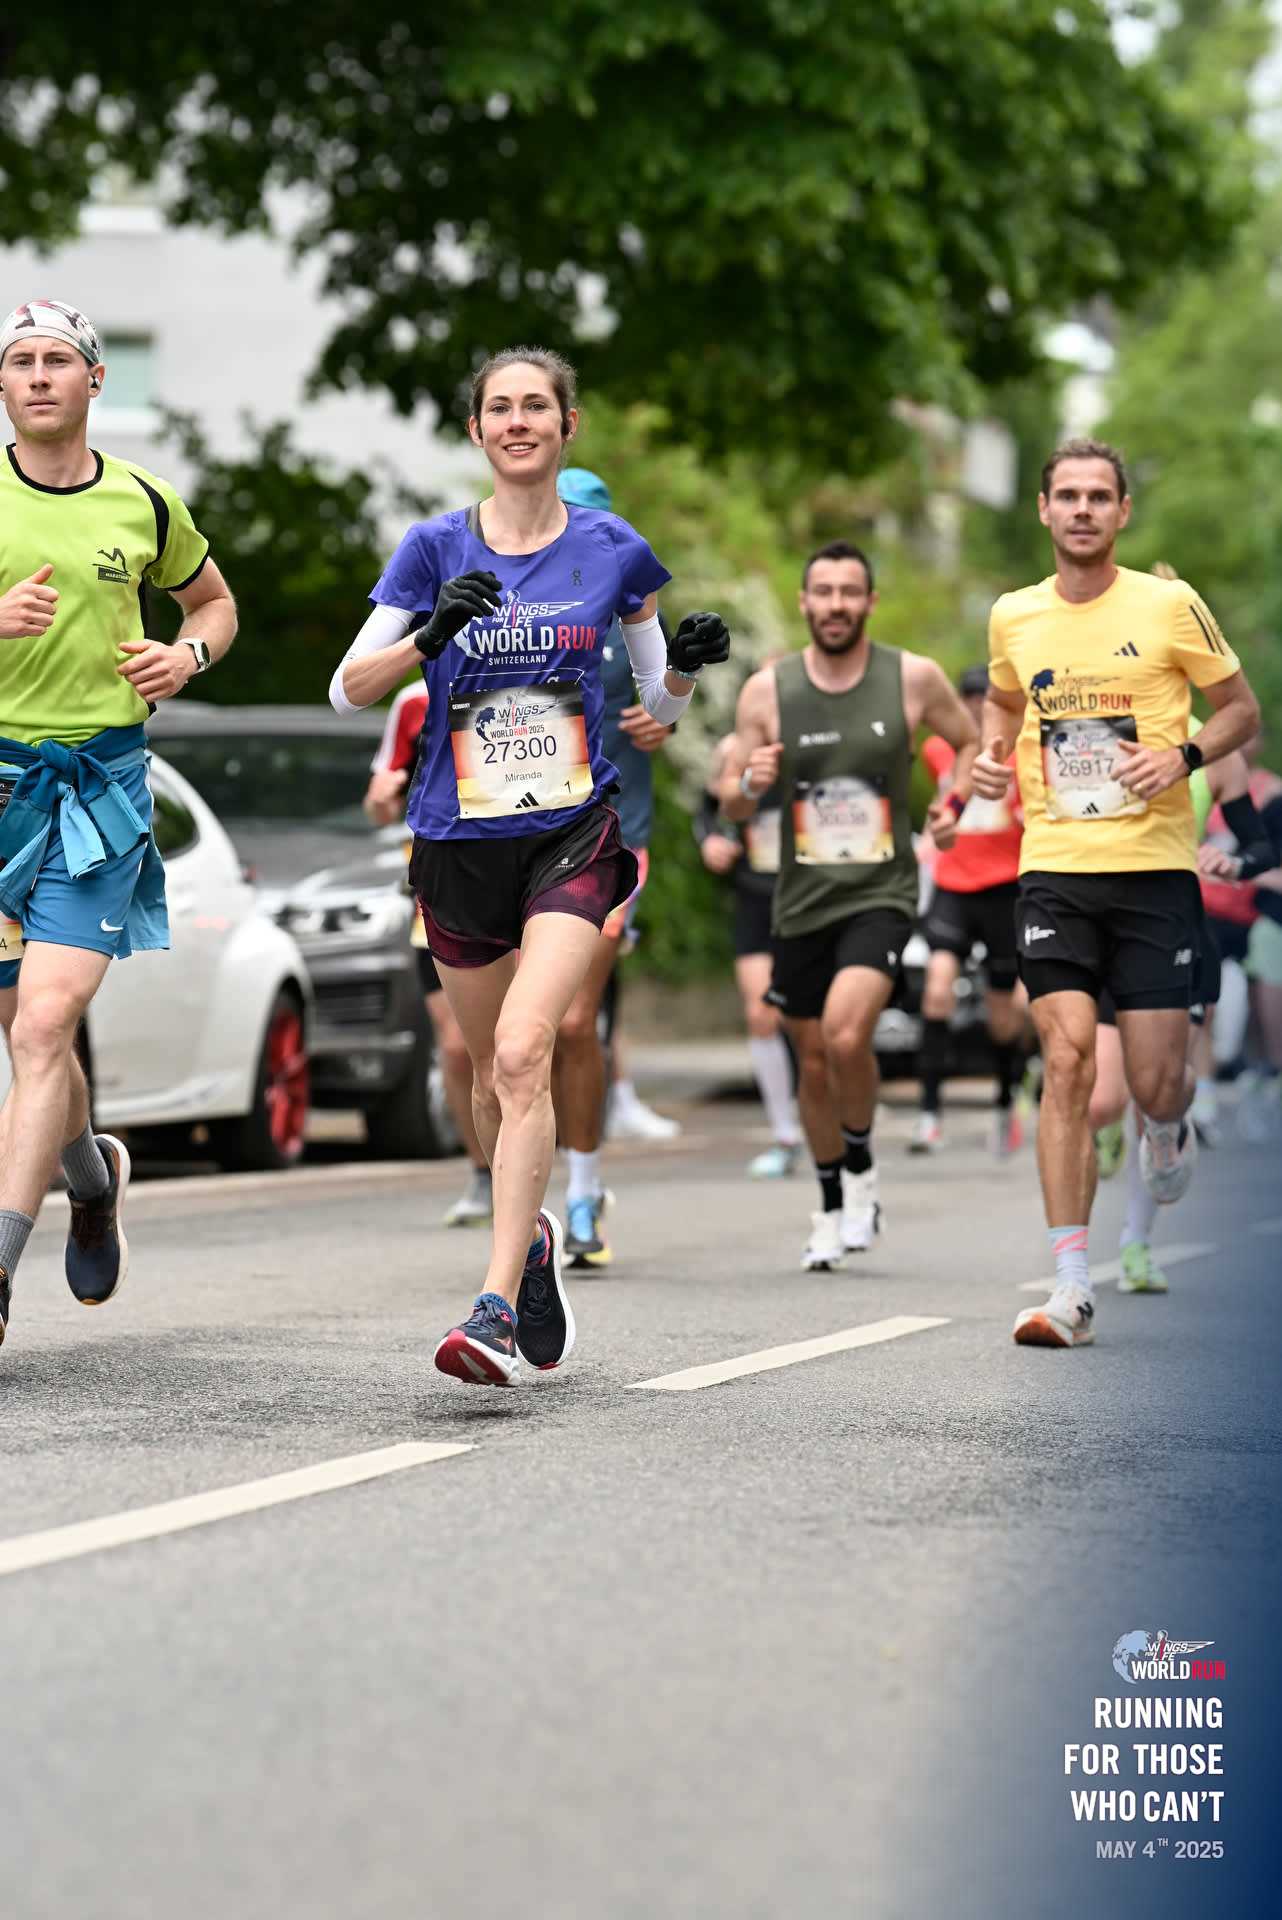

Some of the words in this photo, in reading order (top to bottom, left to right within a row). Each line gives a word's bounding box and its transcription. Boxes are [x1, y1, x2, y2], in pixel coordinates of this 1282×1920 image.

[494, 603, 550, 618] WINGS
[503, 615, 536, 628] LIFE
[474, 626, 555, 655] WORLD
[557, 624, 597, 651] RUN
[488, 654, 548, 666] SWITZERLAND
[1046, 693, 1098, 712] WORLD
[1100, 693, 1132, 710] RUN
[498, 704, 541, 720] WINGS
[505, 715, 528, 728] LIFE
[490, 728, 514, 740] WORLD
[514, 726, 529, 737] RUN
[528, 725, 545, 735] 2025
[482, 735, 557, 765] 27300
[1057, 757, 1115, 778] 26917
[505, 770, 543, 783] Miranda
[564, 780, 572, 794] 1
